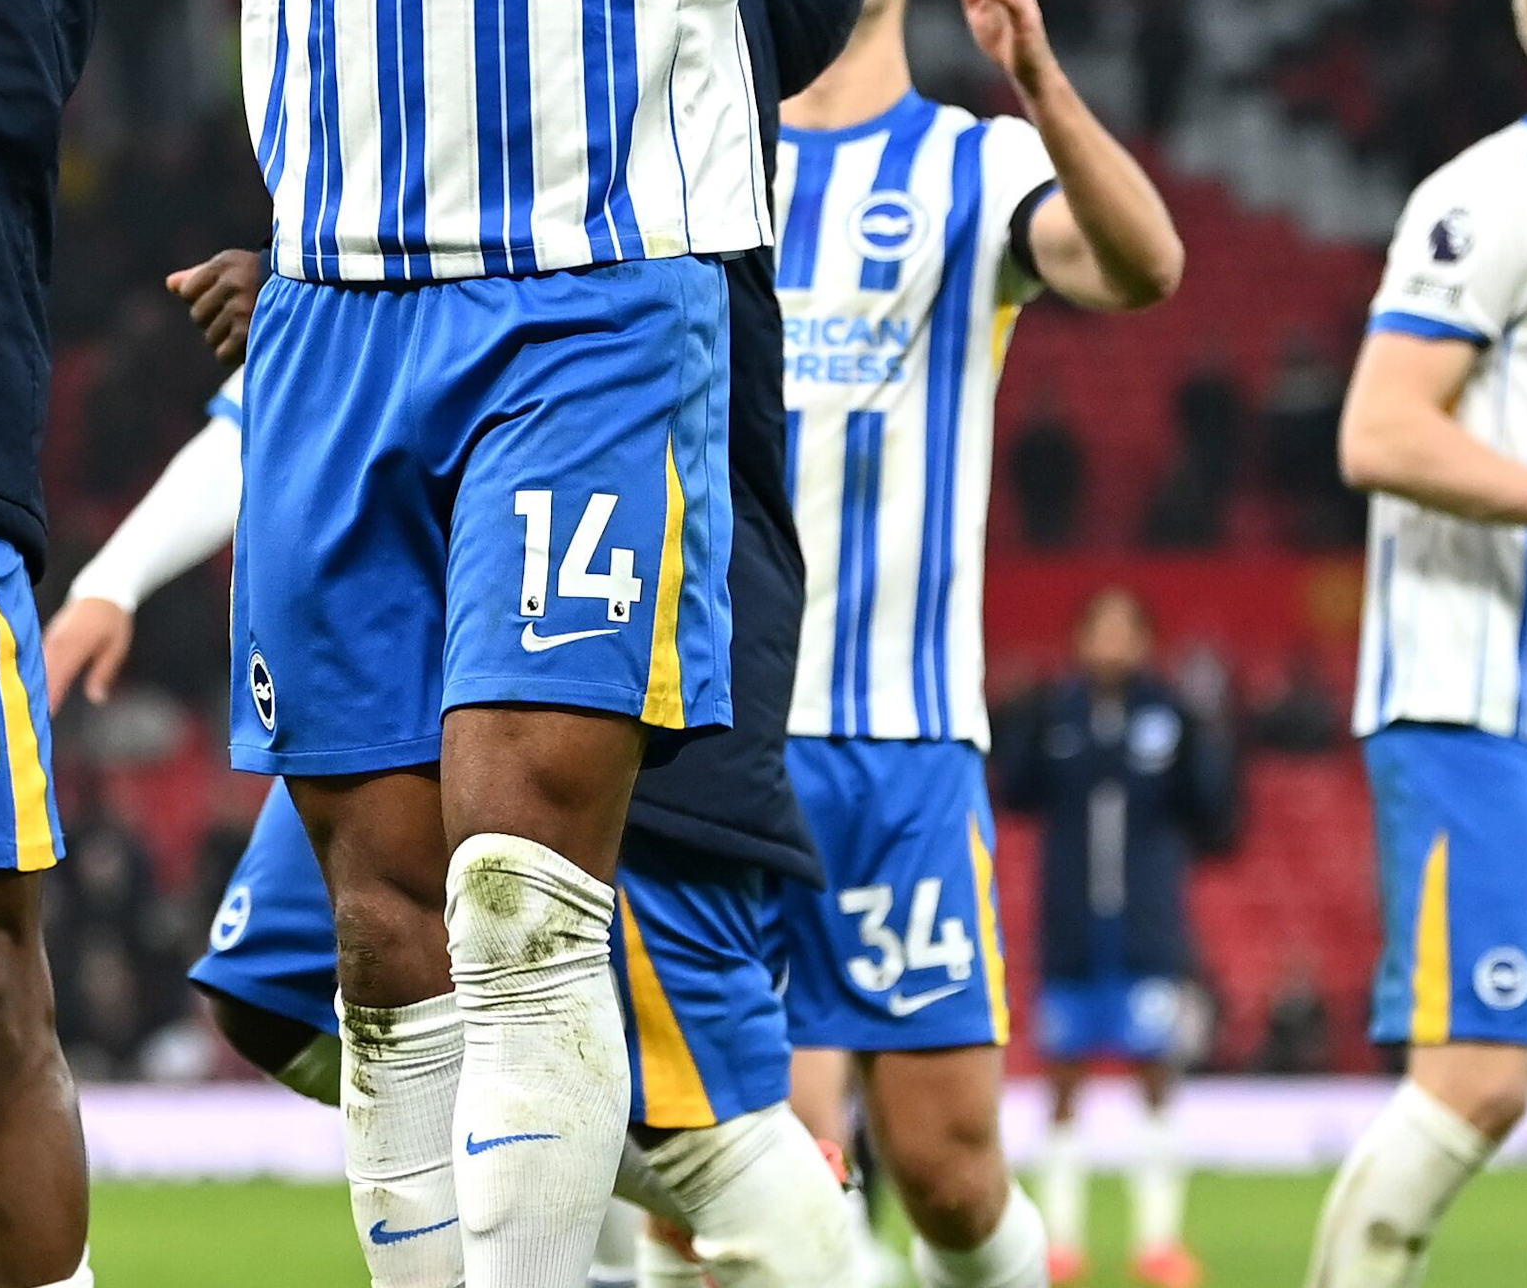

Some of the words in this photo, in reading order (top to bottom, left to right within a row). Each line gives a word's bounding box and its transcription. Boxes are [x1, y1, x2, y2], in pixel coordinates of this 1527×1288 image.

[783, 315, 911, 348] RICAN
[784, 352, 908, 383] RESS
[515, 490, 642, 623] 14
[838, 876, 975, 993] 34
